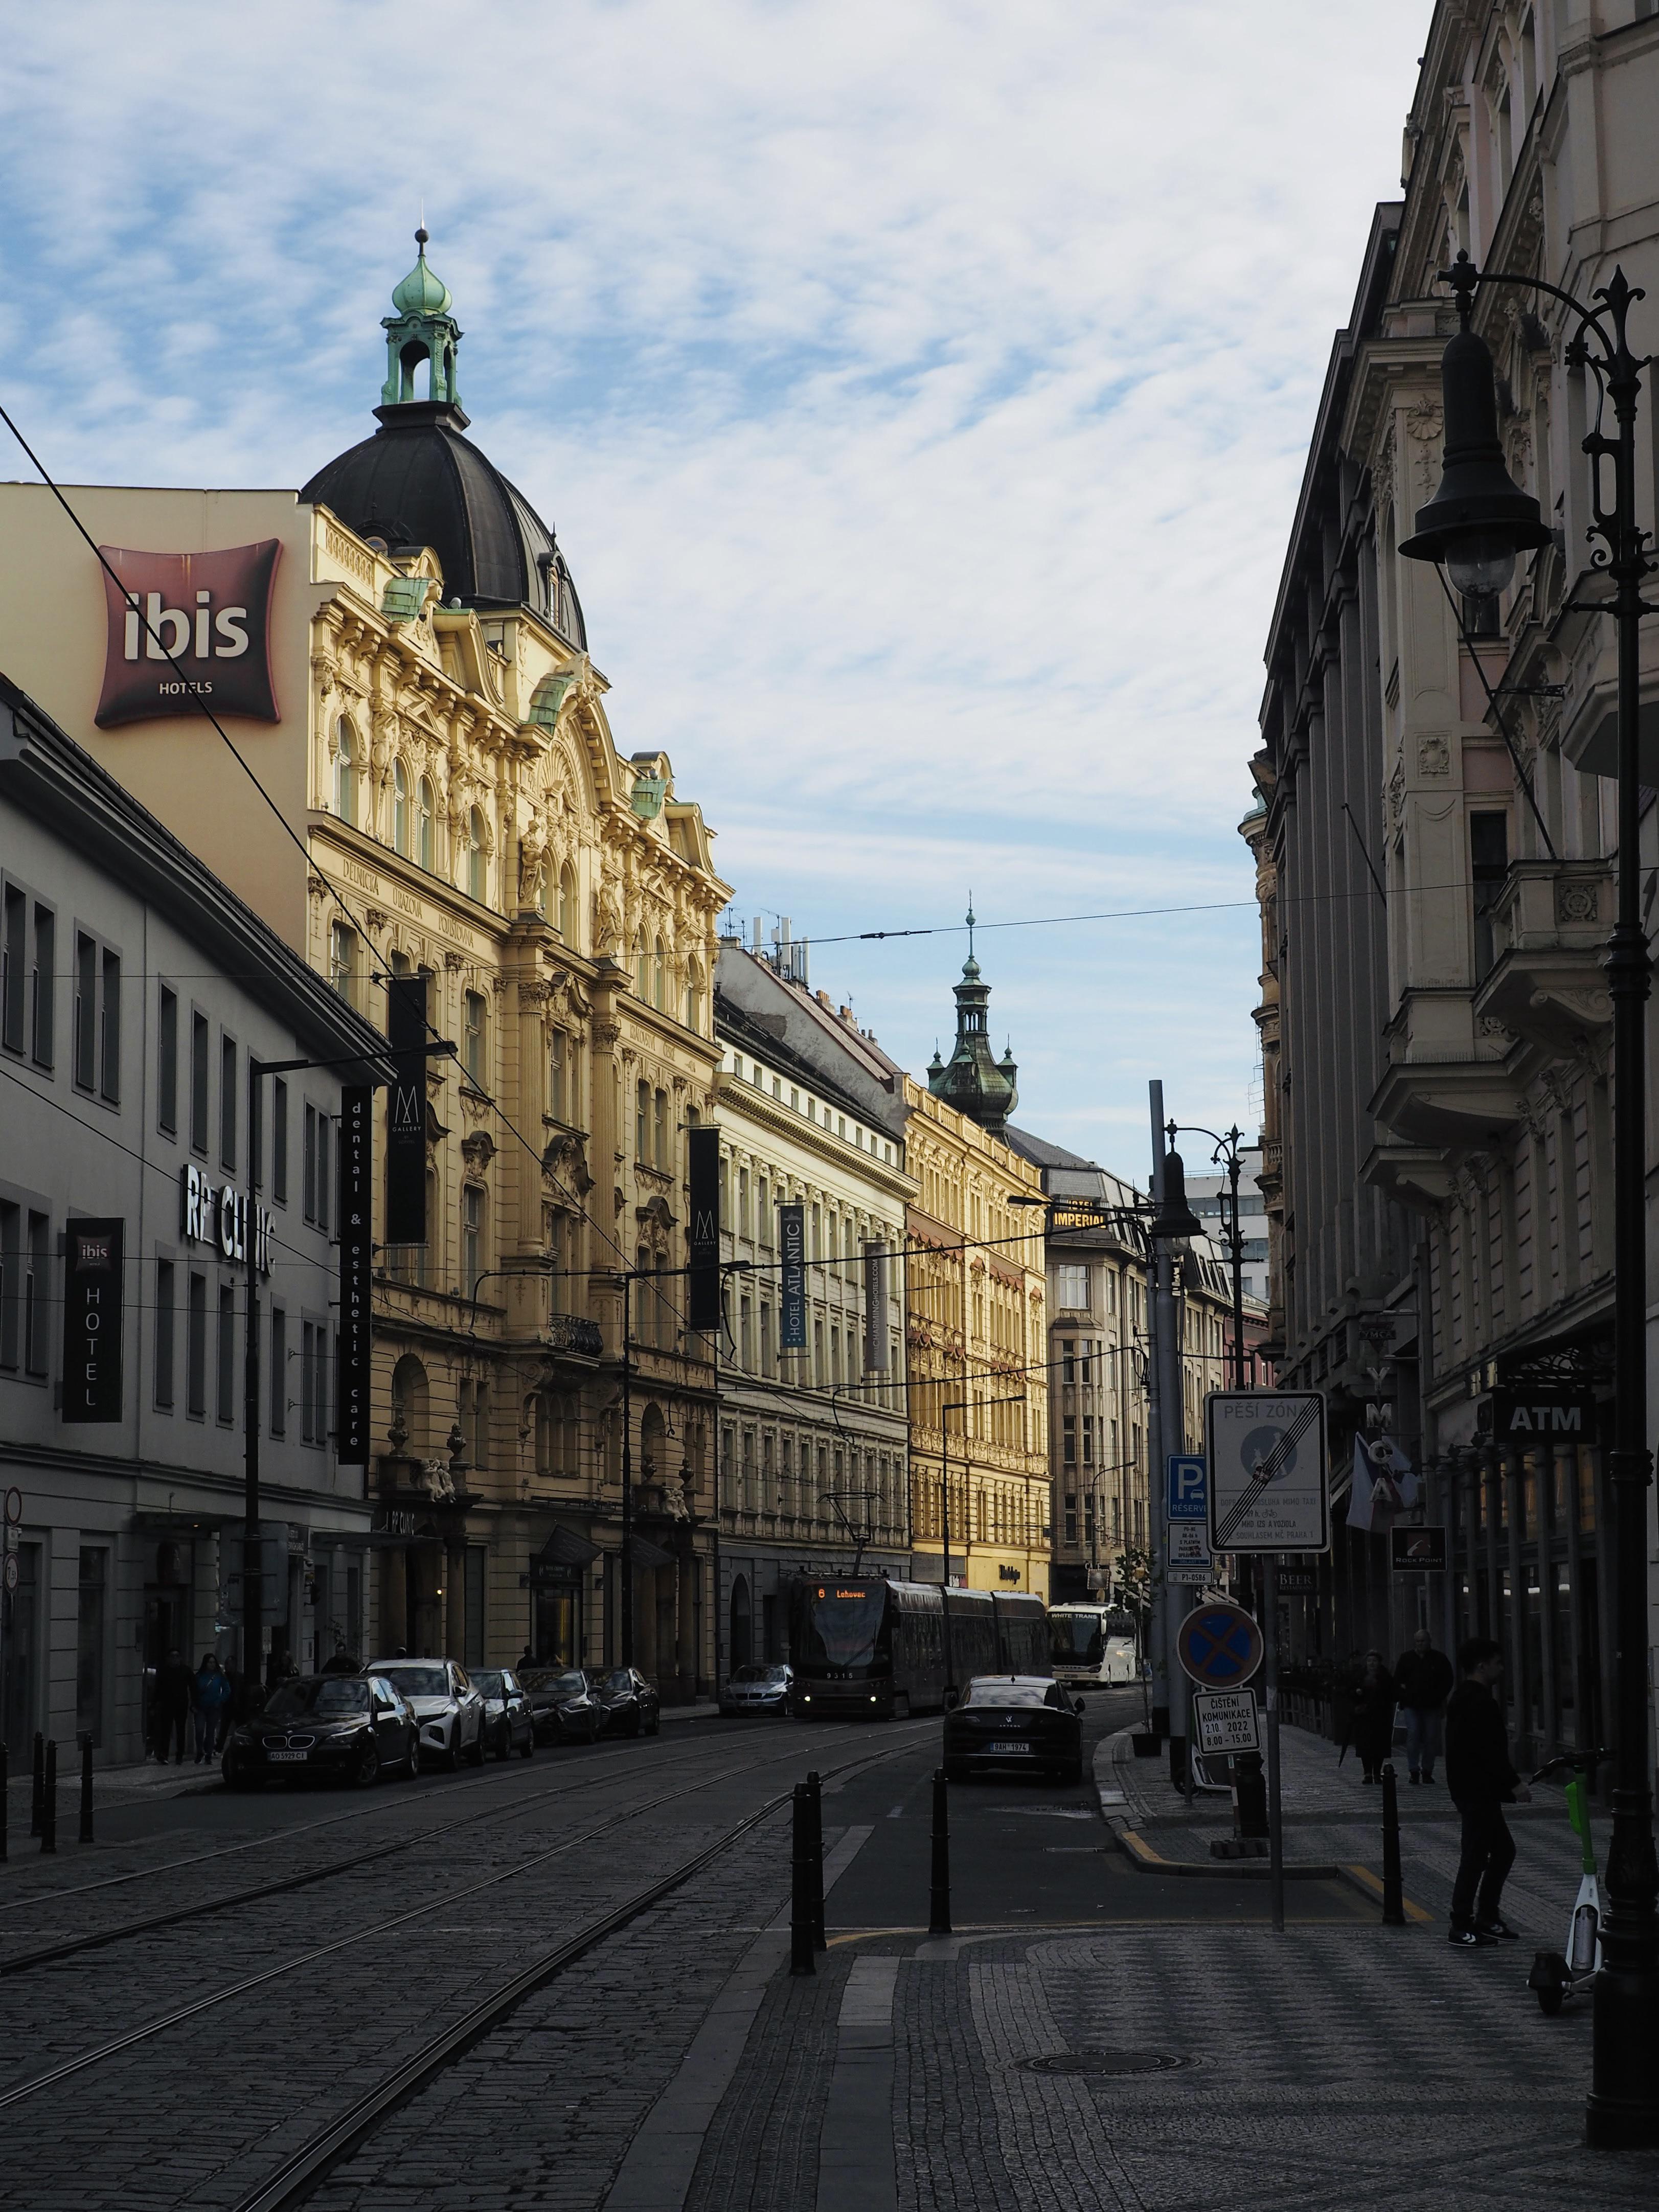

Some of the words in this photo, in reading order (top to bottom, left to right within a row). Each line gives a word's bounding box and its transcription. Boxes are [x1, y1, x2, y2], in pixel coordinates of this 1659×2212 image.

[124, 590, 249, 660] ibis
[160, 681, 213, 695] HOTELS
[352, 1102, 361, 1193] dental
[1054, 1212, 1106, 1229] IMPERIAL
[82, 1245, 107, 1259] ibis
[786, 1224, 801, 1296] ATLANTIC
[351, 1246, 360, 1366] esthetic
[789, 1299, 800, 1335] HOTEL
[85, 1288, 100, 1406] HOTEL
[350, 1389, 358, 1446] care
[1224, 1402, 1260, 1418] PĚŠÍ
[1510, 1406, 1581, 1431] ATM
[1366, 1367, 1393, 1502] YMCA
[1178, 1464, 1203, 1499] P
[1280, 1574, 1312, 1585] BEER
[818, 1588, 825, 1599] 6
[836, 1589, 866, 1598] Lehovec
[1211, 1695, 1239, 1709] ČIŠTĚNÍ
[1202, 1708, 1251, 1722] KOMUNIKACE
[1206, 1723, 1221, 1734] 2.10.
[1228, 1721, 1248, 1732] 2022
[1207, 1736, 1222, 1746] 8.00
[1232, 1733, 1251, 1744] 15.00
